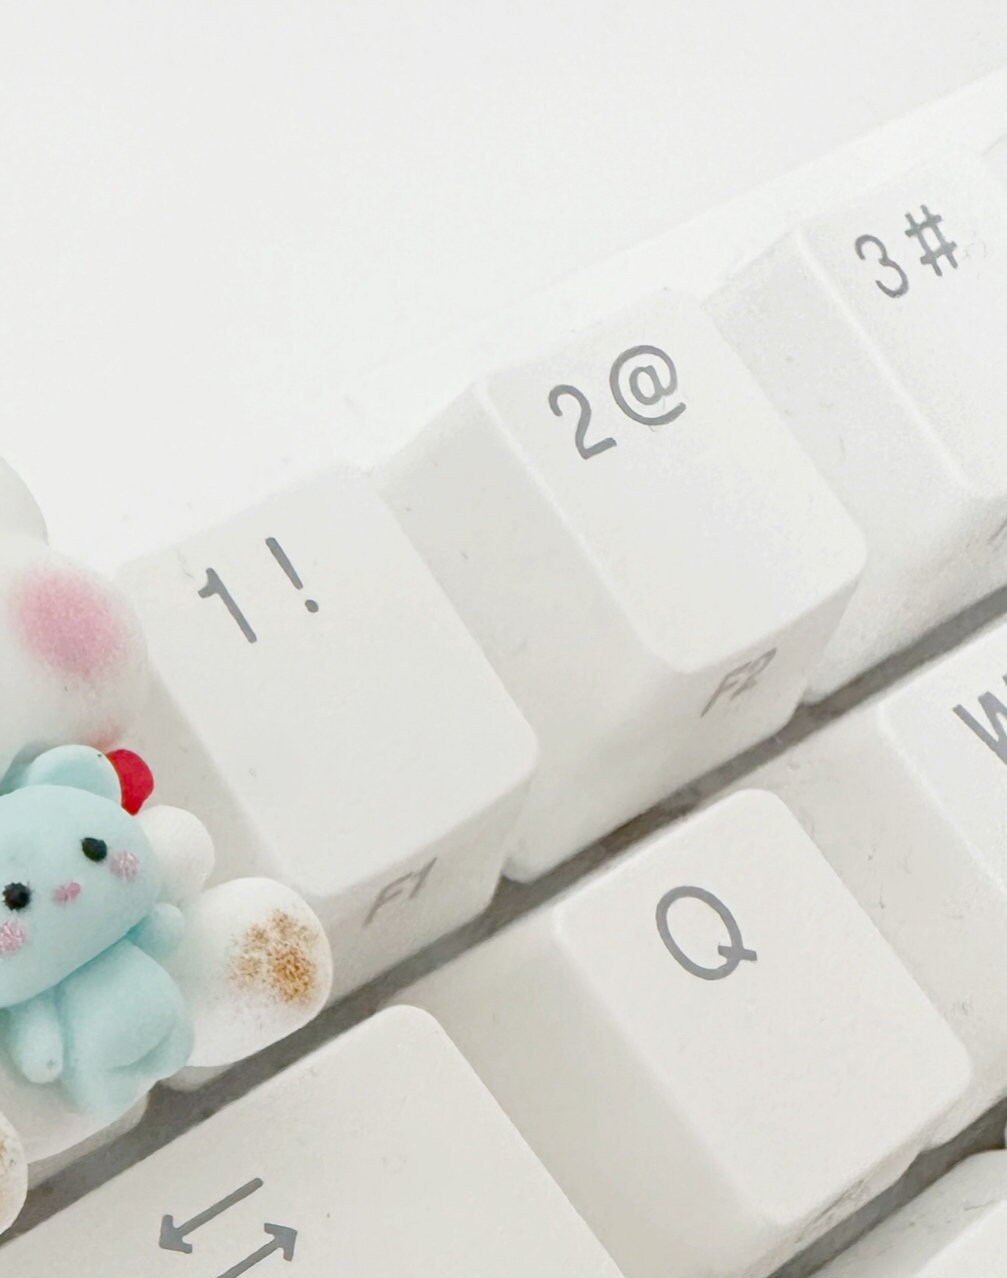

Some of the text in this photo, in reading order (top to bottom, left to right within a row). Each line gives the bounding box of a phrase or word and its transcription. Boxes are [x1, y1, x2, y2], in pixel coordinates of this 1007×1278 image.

[854, 204, 959, 299] 3#
[547, 344, 687, 461] 2@
[700, 647, 777, 718] F2
[362, 856, 438, 929] F1
[655, 885, 758, 981] Q
